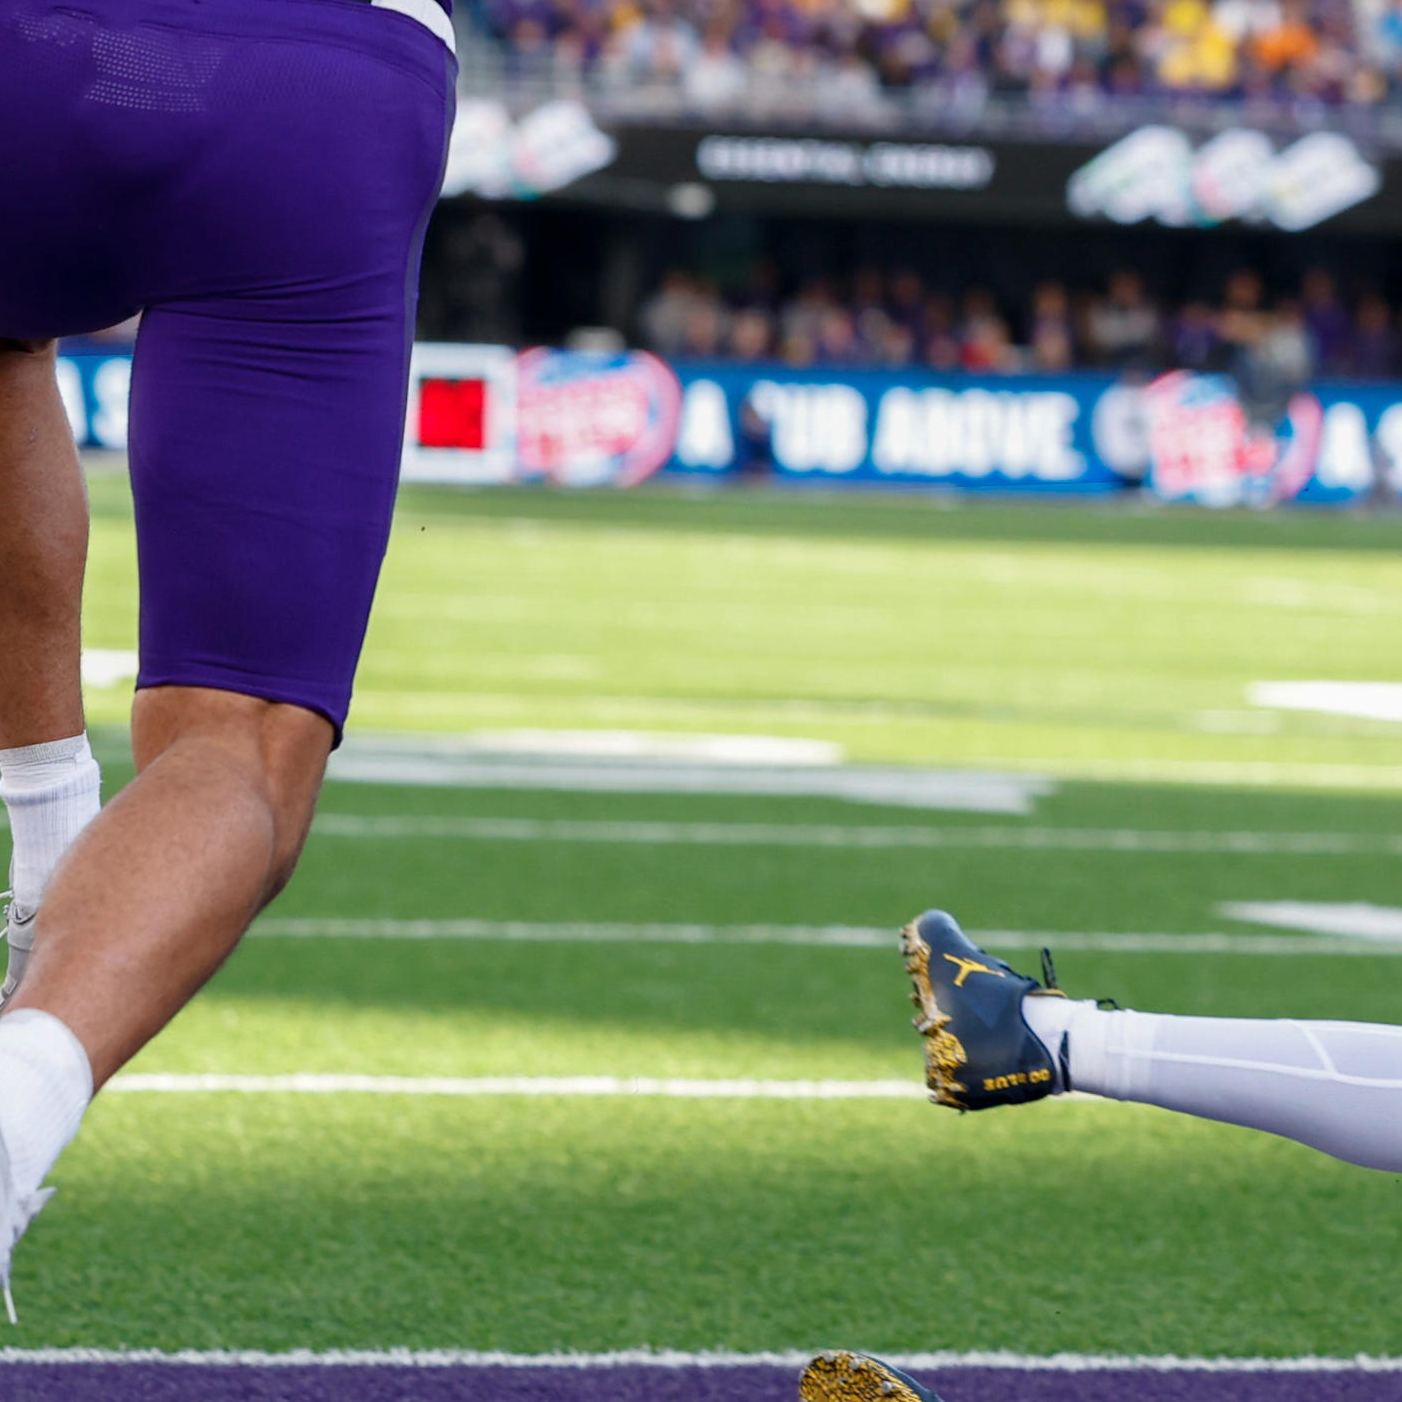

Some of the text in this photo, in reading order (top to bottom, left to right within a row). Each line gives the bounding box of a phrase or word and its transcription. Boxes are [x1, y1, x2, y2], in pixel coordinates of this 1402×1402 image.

[677, 379, 733, 469] A
[872, 386, 1087, 481] ABOVE
[1315, 402, 1373, 492] A
